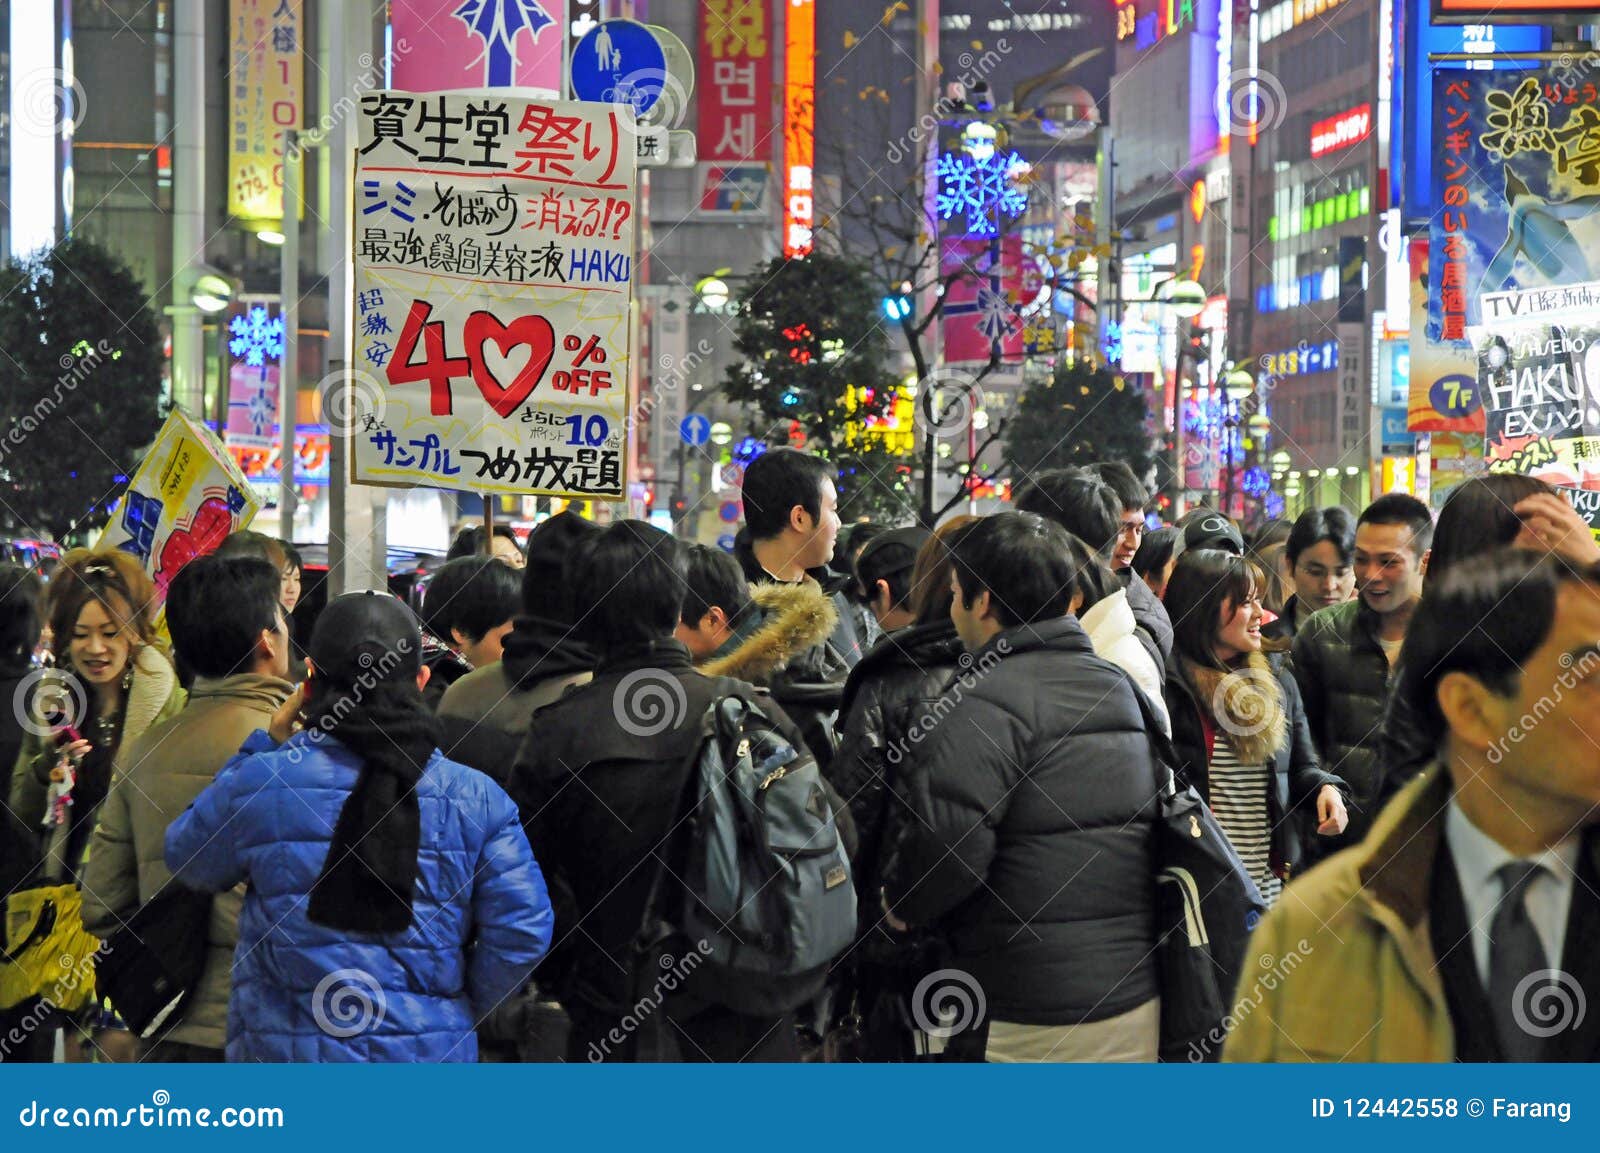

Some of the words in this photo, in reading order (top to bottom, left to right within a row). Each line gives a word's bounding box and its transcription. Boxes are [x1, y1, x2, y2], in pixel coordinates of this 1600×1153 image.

[714, 61, 756, 159] 면세
[1442, 80, 1471, 340] ペンギンのいる居酒屋
[568, 247, 631, 282] HAKU
[552, 368, 612, 397] OFF
[1442, 380, 1473, 409] 7F
[1487, 362, 1586, 412] HAKU
